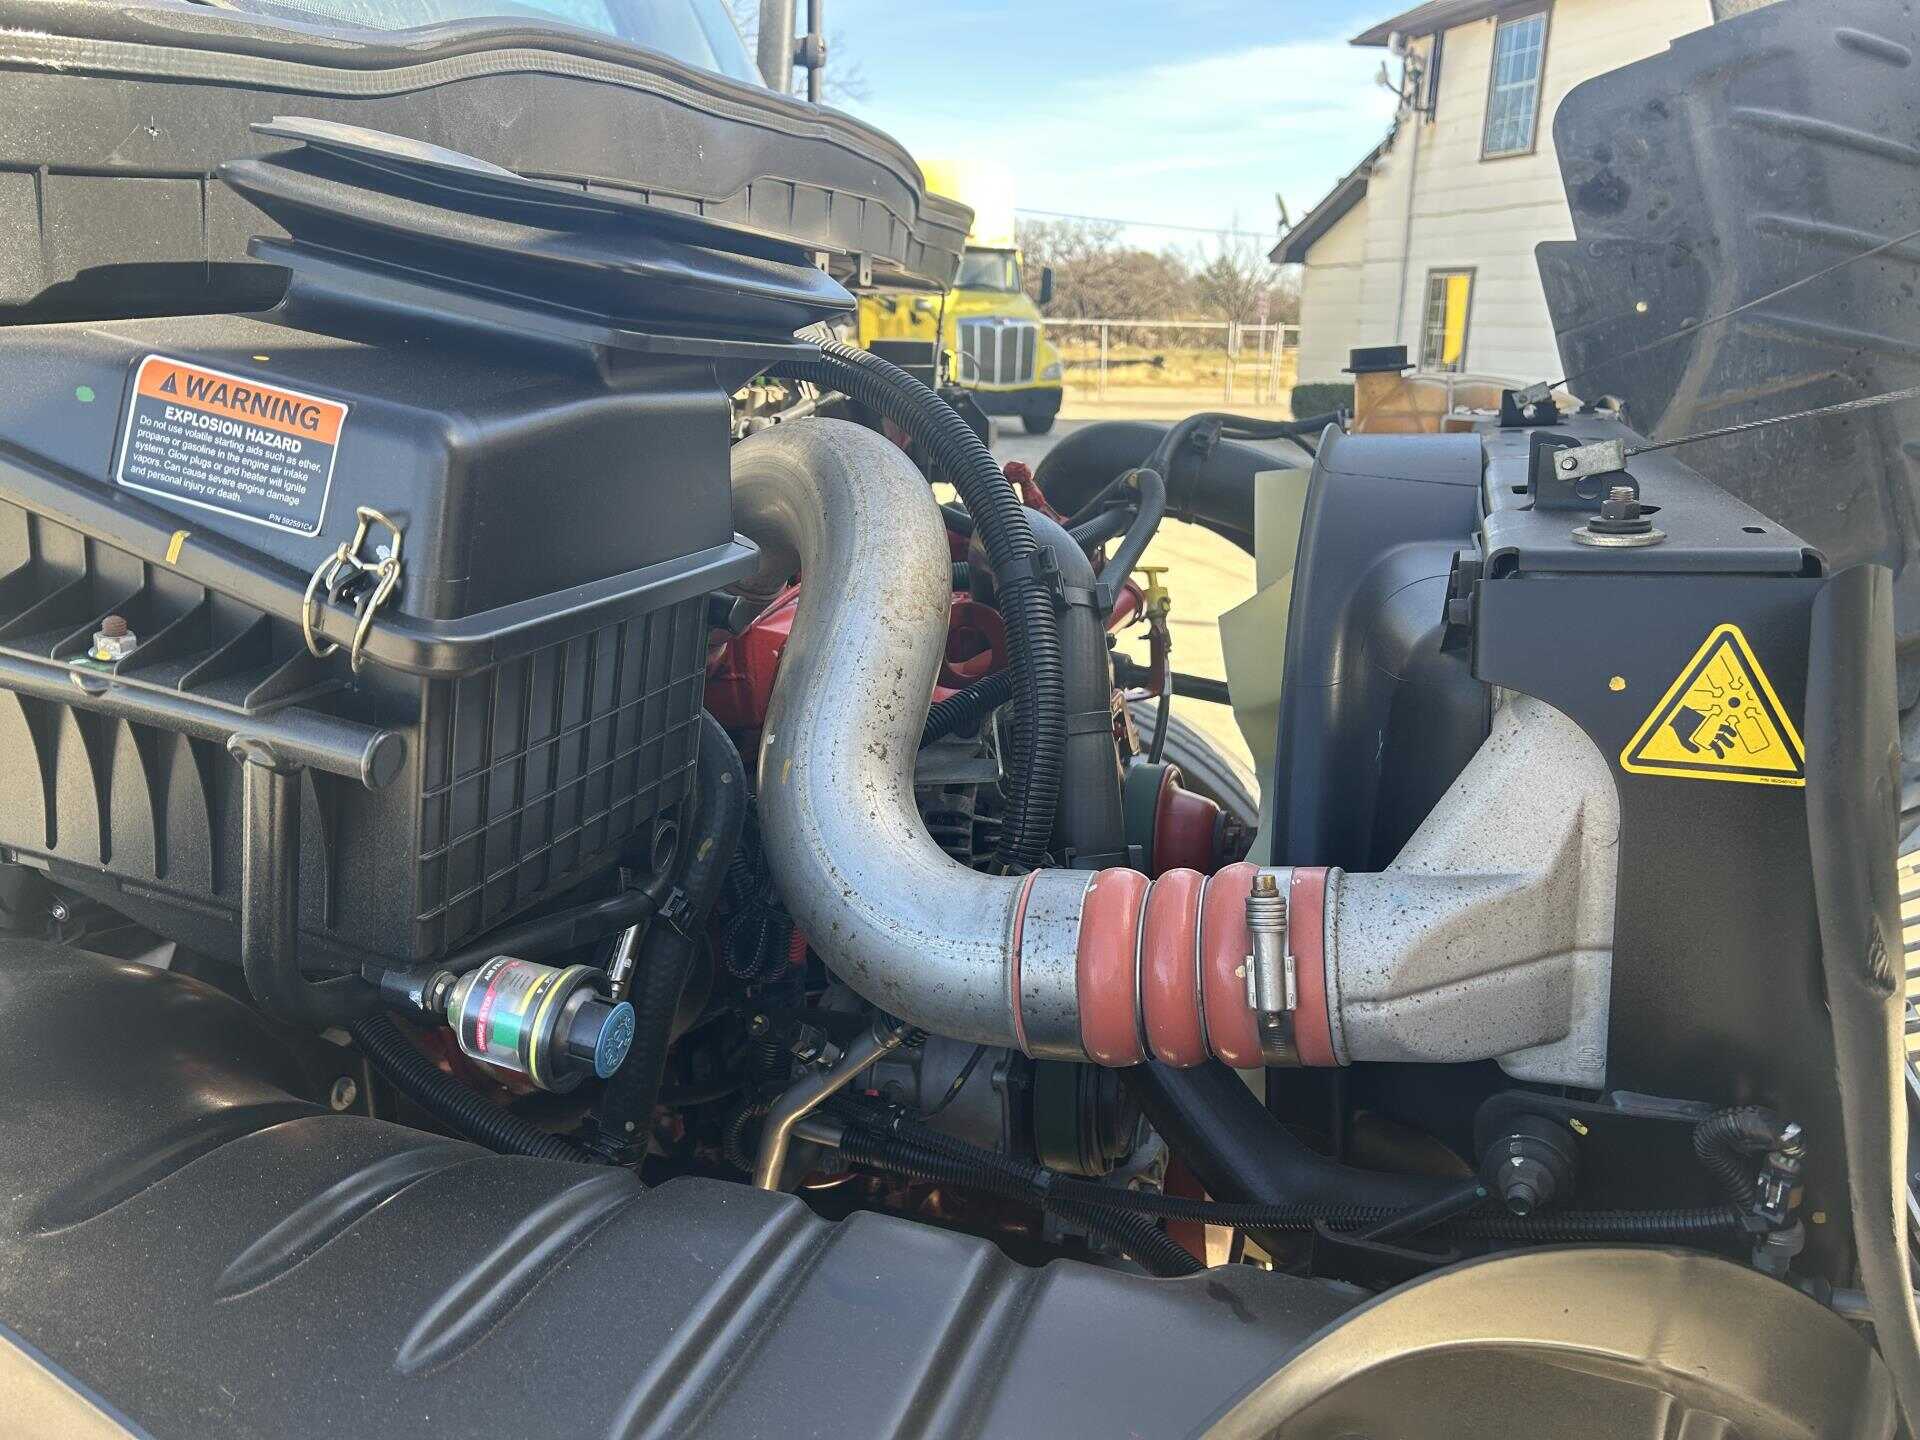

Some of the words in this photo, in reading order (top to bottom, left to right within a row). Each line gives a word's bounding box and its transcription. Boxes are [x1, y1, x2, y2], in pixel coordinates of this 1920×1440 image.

[164, 406, 242, 438] EXPLOSION
[245, 427, 302, 454] HAZARD
[185, 375, 321, 431] WARNING
[134, 439, 166, 457] system.
[167, 448, 189, 461] Glow
[189, 454, 212, 470] plugs
[213, 462, 222, 471] or
[223, 463, 240, 478] grid
[240, 468, 267, 484] heater
[268, 476, 282, 488] will
[283, 480, 306, 496] ignite
[136, 428, 170, 446] propane
[171, 437, 181, 447] or
[181, 439, 216, 458] gasoline
[217, 449, 226, 459] in
[226, 451, 240, 463] the
[240, 456, 269, 473] engine
[270, 464, 281, 474] air
[282, 467, 308, 481] intake
[139, 414, 152, 426] Do
[152, 418, 167, 430] not
[167, 424, 183, 435] use
[183, 427, 213, 443] volatile
[213, 435, 244, 453] starting
[245, 443, 263, 456] aids
[264, 448, 285, 462] such
[286, 456, 297, 465] as
[297, 458, 322, 473] ether,
[130, 463, 146, 475] and
[146, 468, 182, 487] personal
[182, 478, 205, 494] injury
[206, 486, 215, 495] or
[216, 487, 242, 503] death.
[131, 452, 162, 469] vapors.
[163, 460, 181, 472] Can
[181, 466, 207, 480] cause
[207, 473, 235, 488] severe
[236, 481, 264, 498] engine
[265, 488, 300, 508] damage
